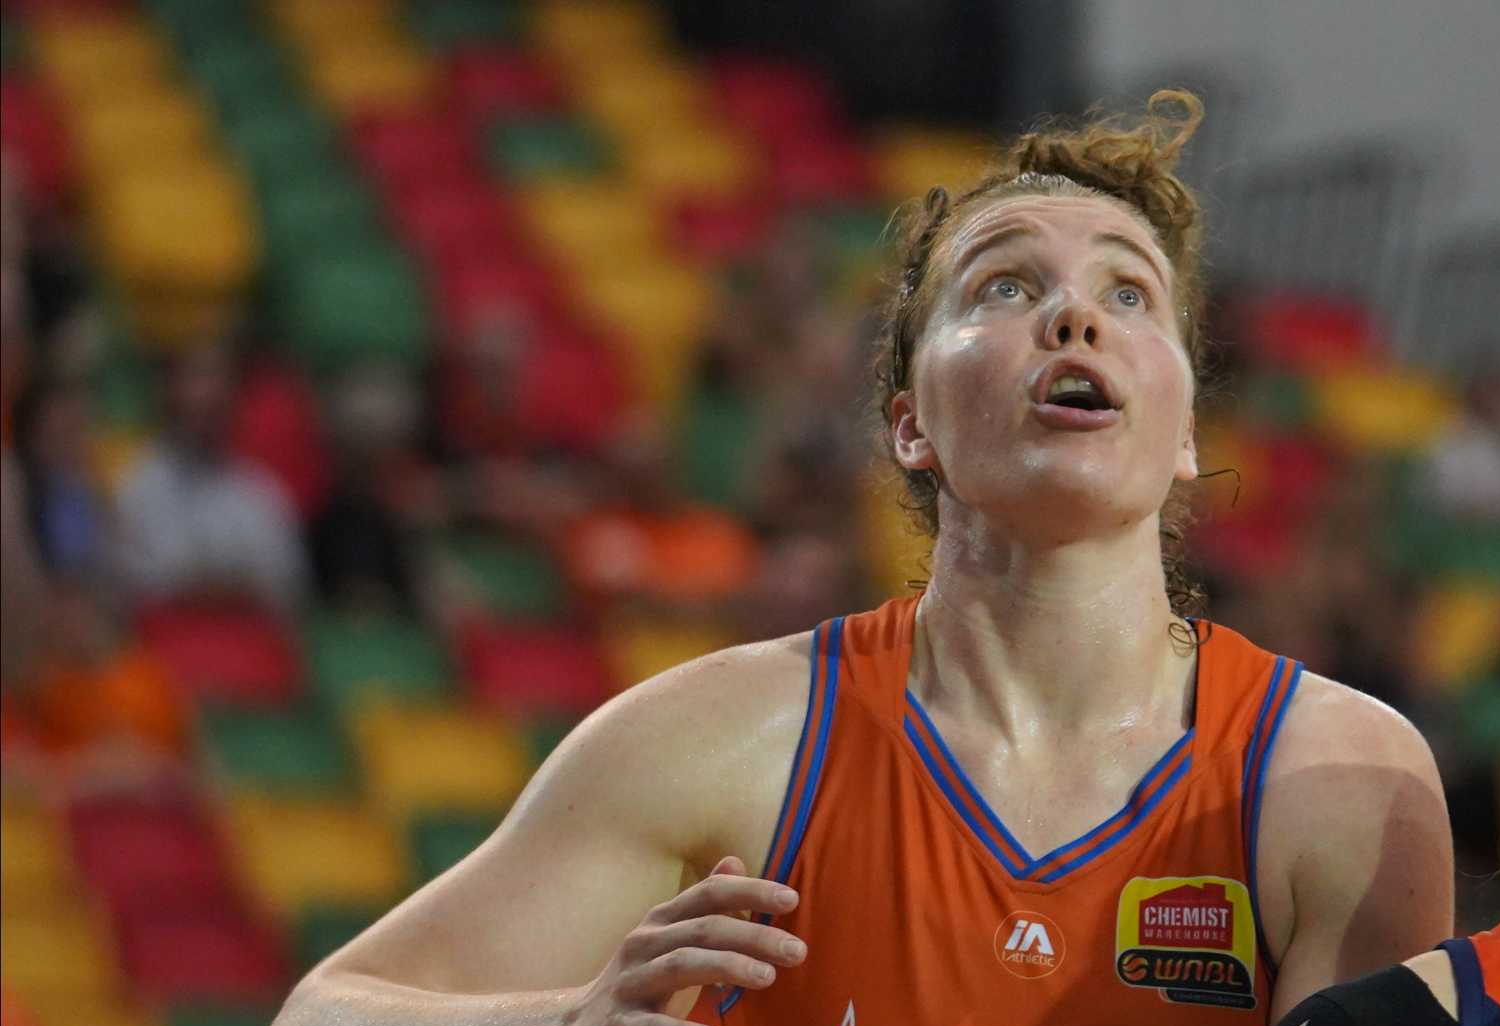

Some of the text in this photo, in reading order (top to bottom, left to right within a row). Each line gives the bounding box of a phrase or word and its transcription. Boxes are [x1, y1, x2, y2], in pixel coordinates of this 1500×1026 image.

[1144, 906, 1229, 928] CHEMIST
[1144, 929, 1227, 942] WAREHOUSE
[1154, 957, 1243, 987] WNBL
